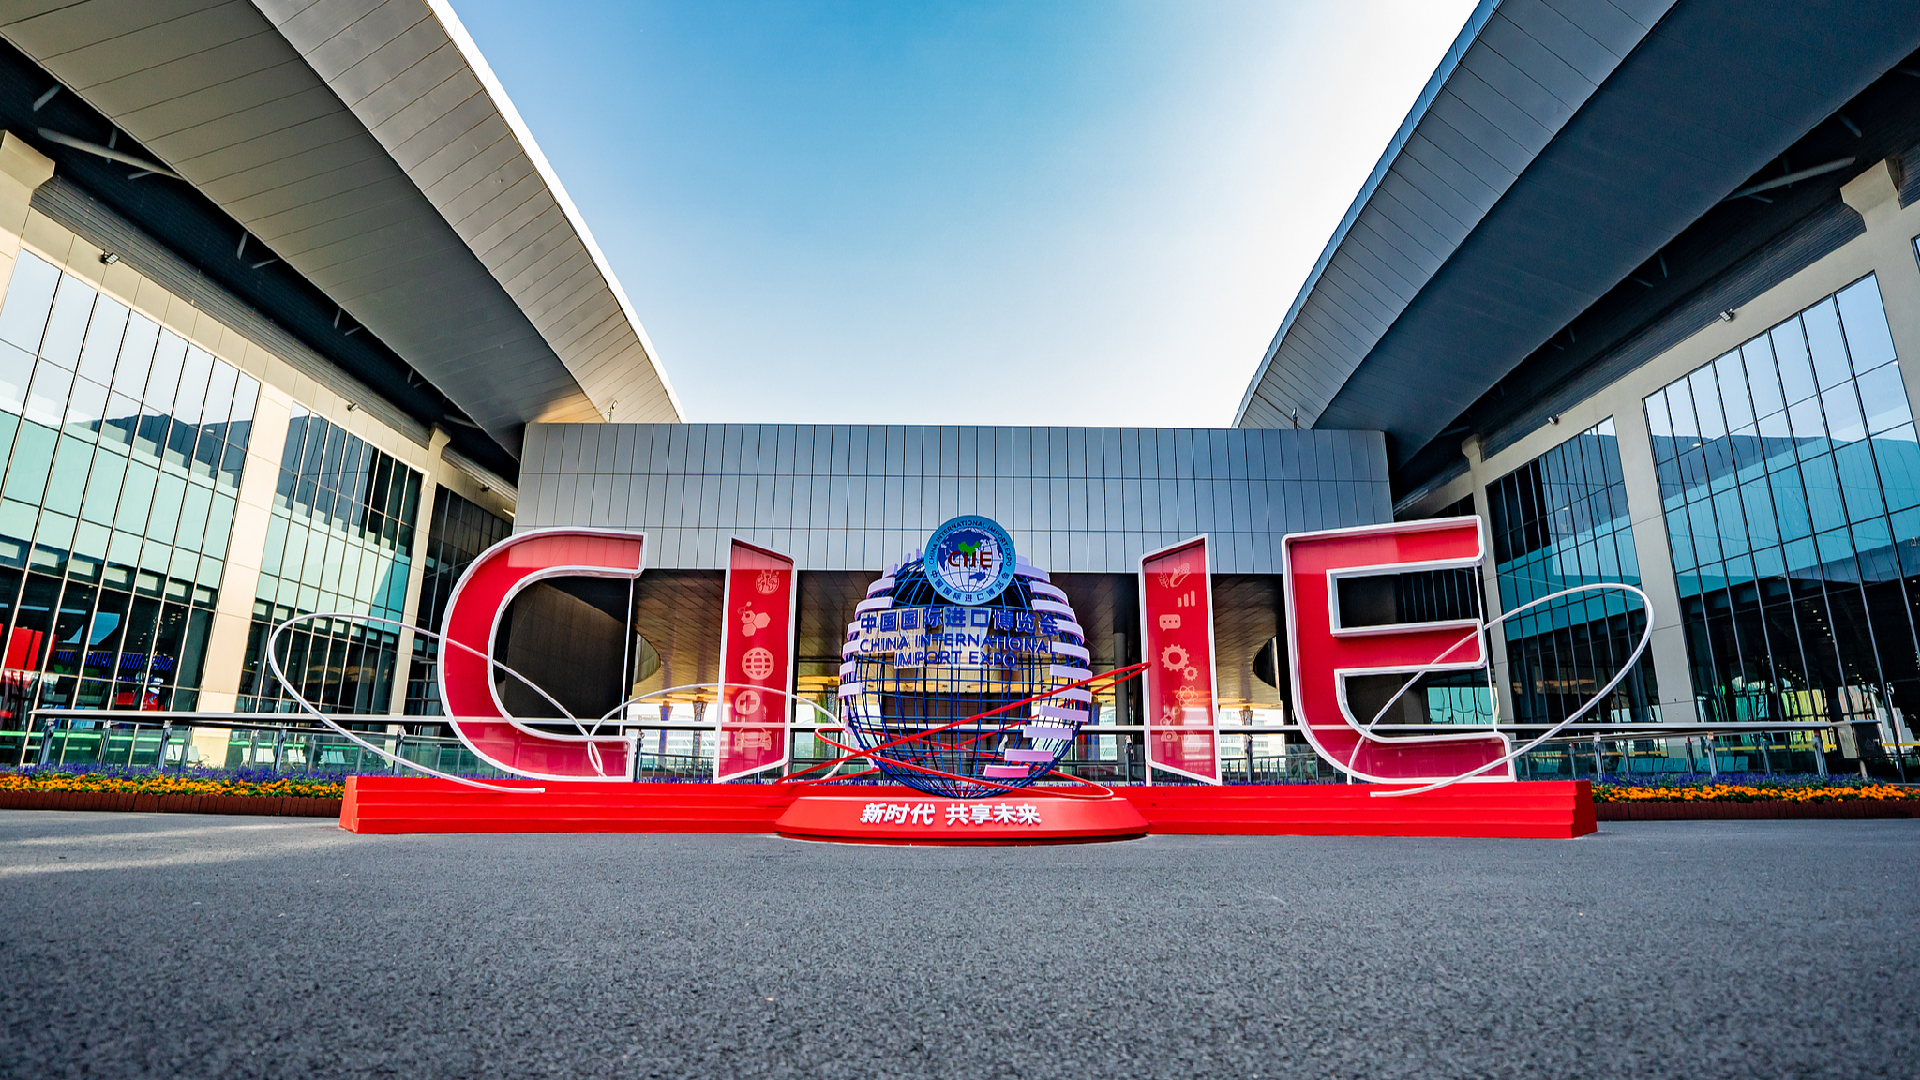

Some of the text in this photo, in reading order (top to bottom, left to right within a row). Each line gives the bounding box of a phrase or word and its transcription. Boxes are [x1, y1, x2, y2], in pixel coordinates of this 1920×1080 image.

[929, 519, 1012, 567] CHINA INTERNATIONAL IMPORT EXPO
[948, 550, 993, 568] CIIE
[930, 569, 1010, 602] 中国国际进口博览会
[860, 607, 1060, 636] 中国国际进口博览会
[860, 633, 1060, 654] CHINA INTERNATIONAL
[894, 650, 1017, 668] IMPORT EXPO
[860, 803, 1043, 825] 新时代 共享未来
